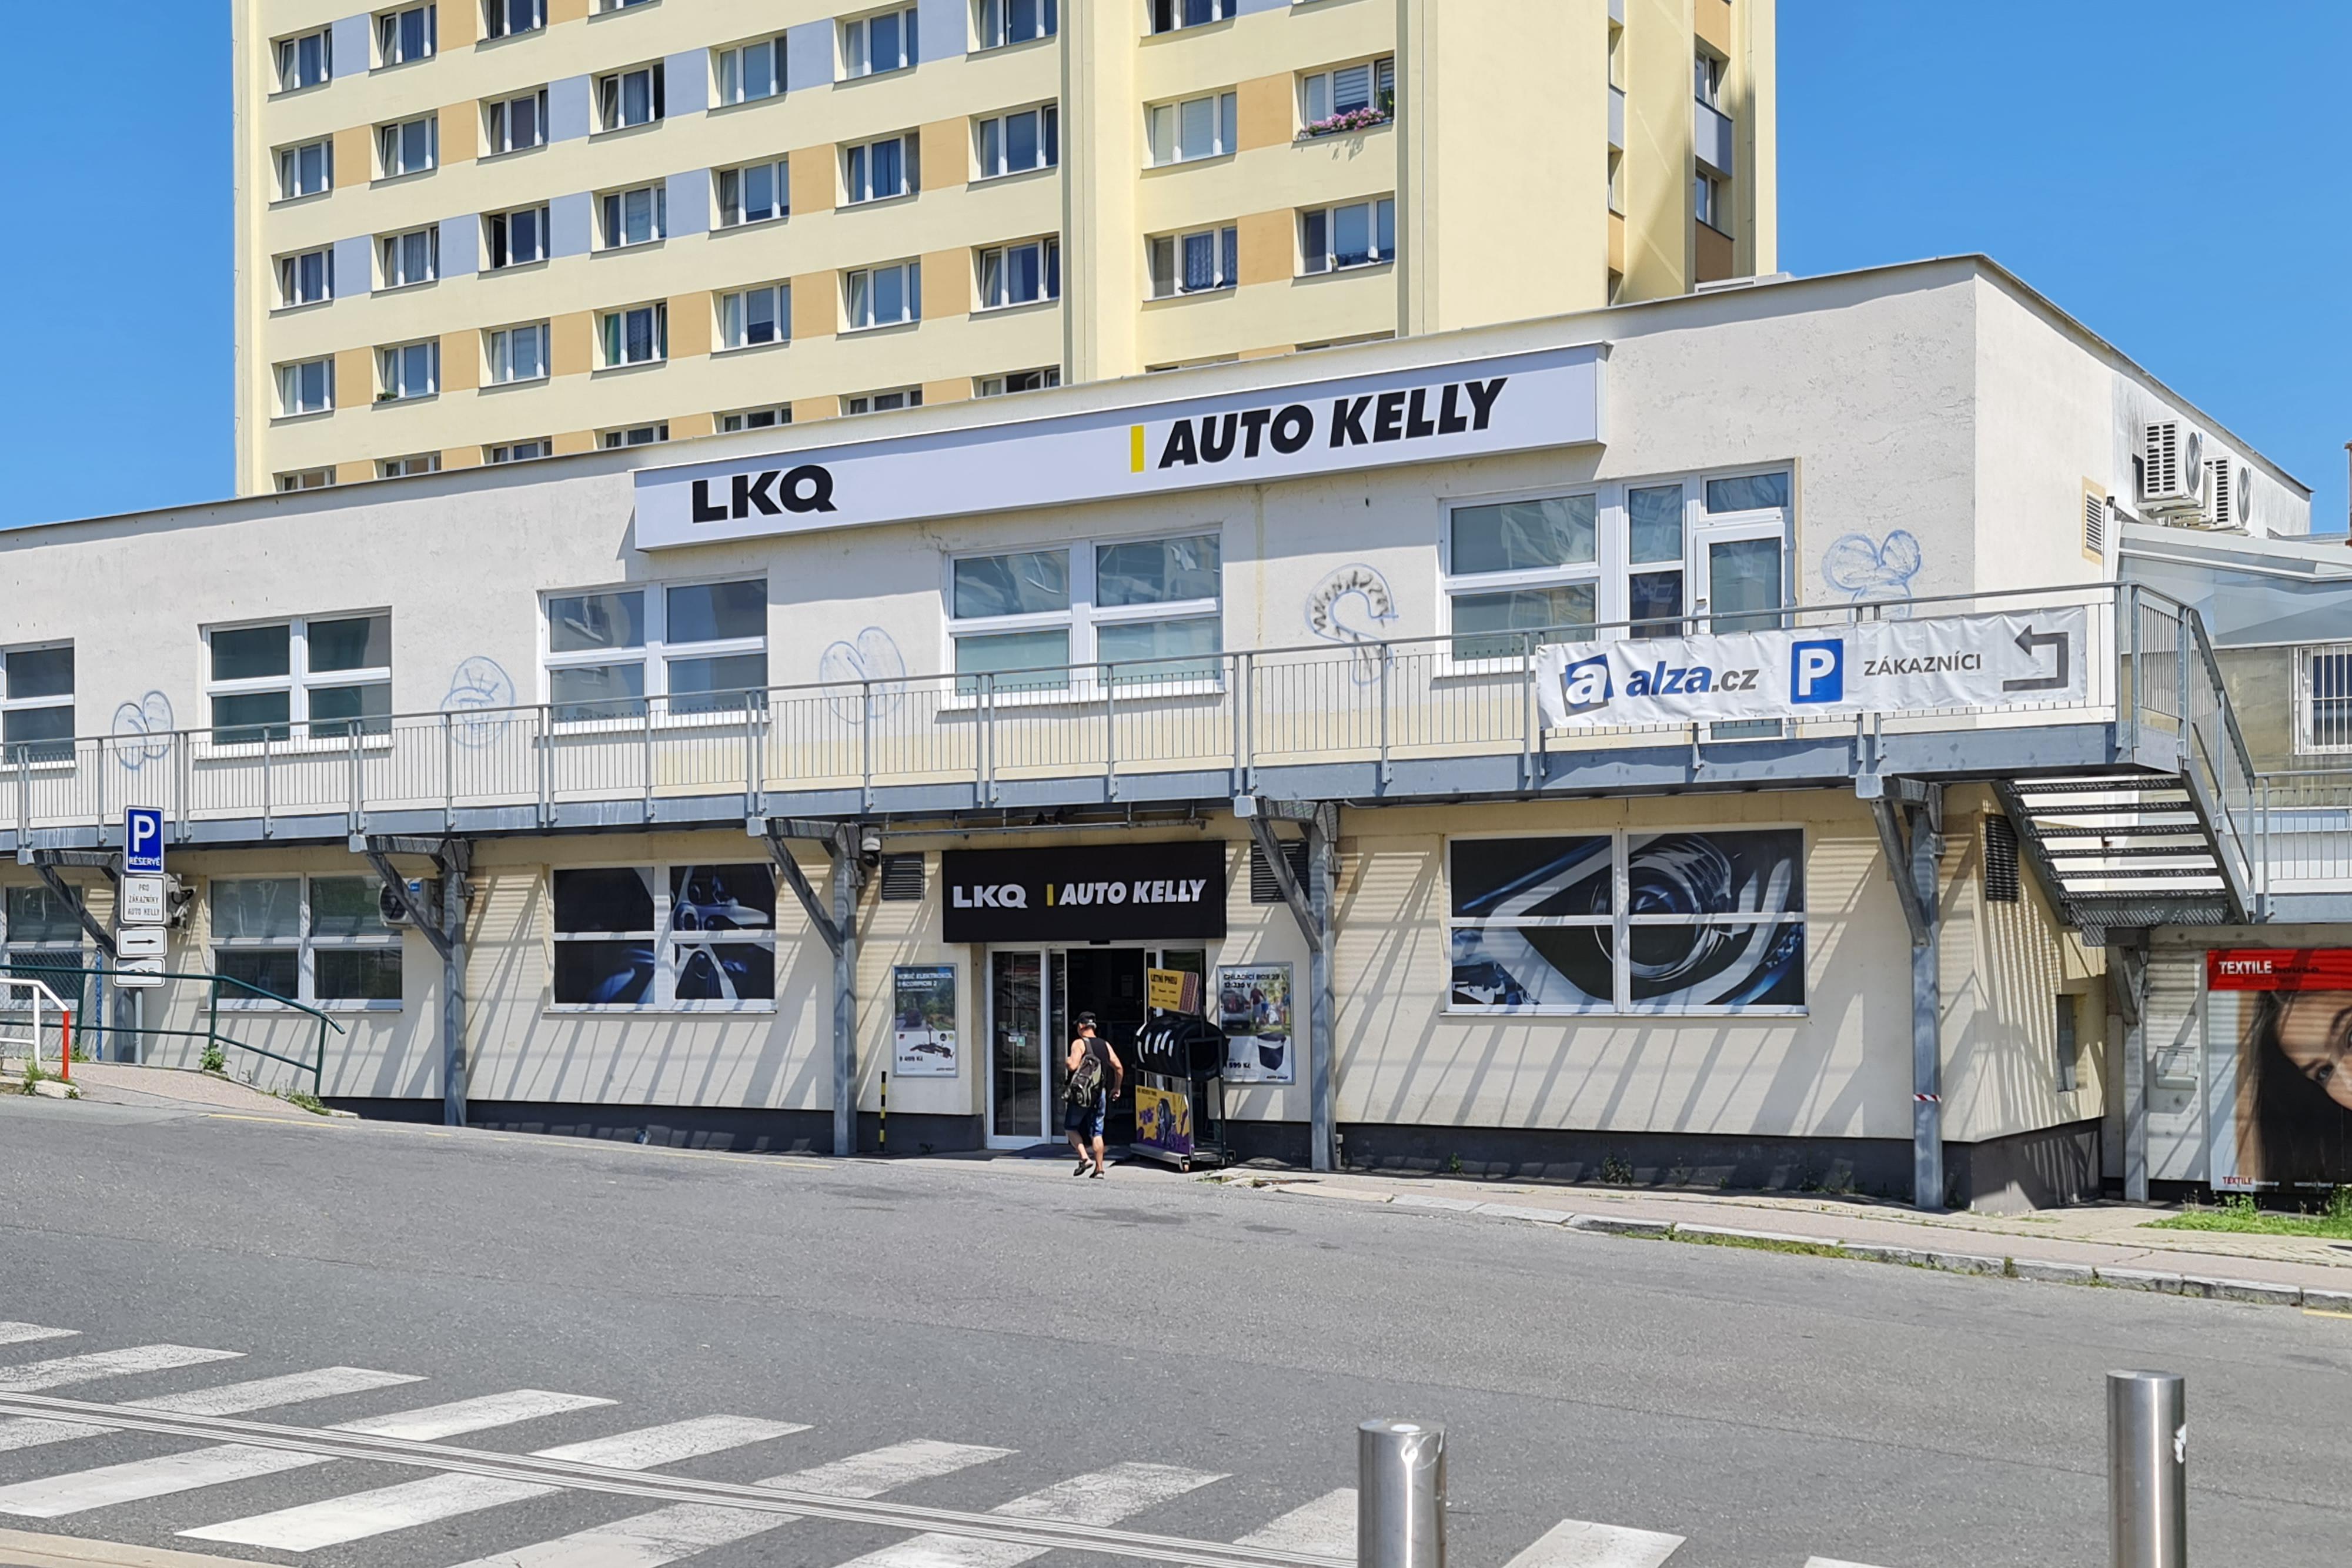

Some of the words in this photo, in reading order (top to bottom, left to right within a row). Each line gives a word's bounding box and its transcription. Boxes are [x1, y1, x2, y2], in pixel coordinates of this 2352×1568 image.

[1158, 404, 1314, 469] AUTO
[1329, 377, 1508, 448] KELLY
[693, 464, 838, 523] LKQ
[1626, 661, 1759, 696] alza.cz
[1798, 648, 1835, 696] P
[1864, 651, 1981, 676] ZÁKAZNÍCI
[133, 815, 155, 852] P
[138, 884, 149, 892] PRO
[953, 884, 1028, 908] LKQ
[1059, 882, 1127, 905] AUTO
[1132, 880, 1207, 903] KELLY
[128, 907, 141, 915] AUTO
[143, 907, 159, 916] KELLY
[2219, 961, 2272, 974] TEXTILE
[2223, 1176, 2252, 1185] TEXTILE
